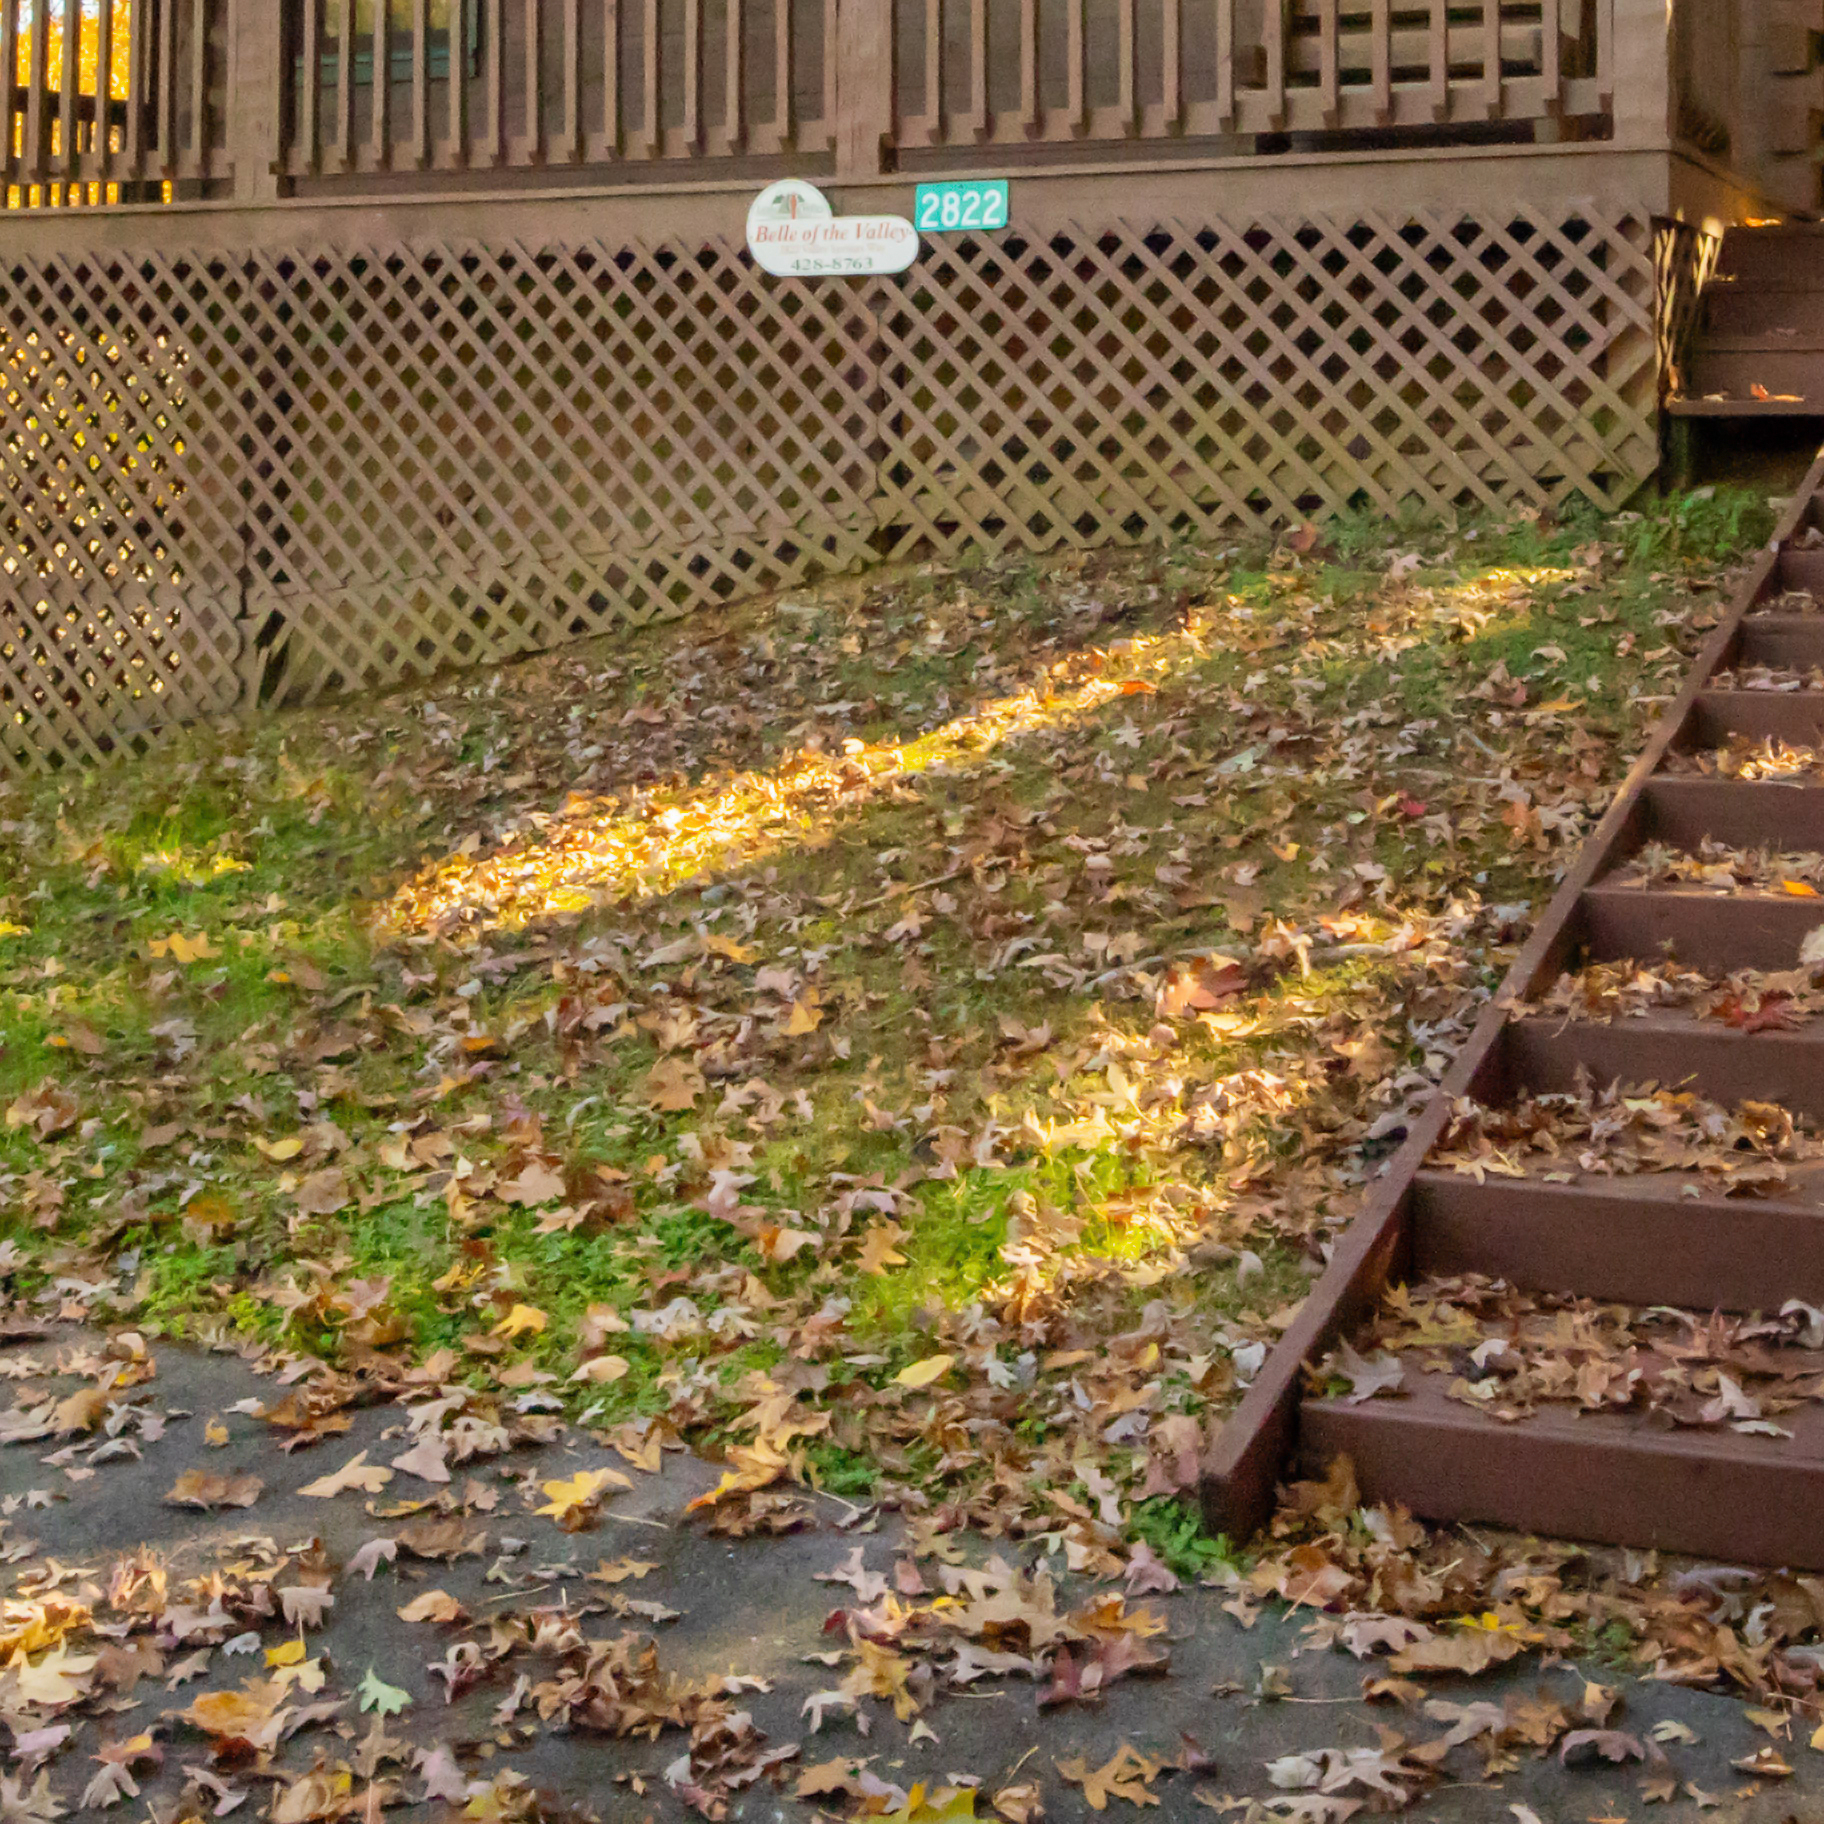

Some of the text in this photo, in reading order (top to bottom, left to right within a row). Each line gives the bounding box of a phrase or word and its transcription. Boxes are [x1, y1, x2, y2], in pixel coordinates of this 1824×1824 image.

[920, 189, 1003, 228] 2822
[755, 222, 908, 245] Belle of the Valley
[790, 257, 874, 271] 428-8763
